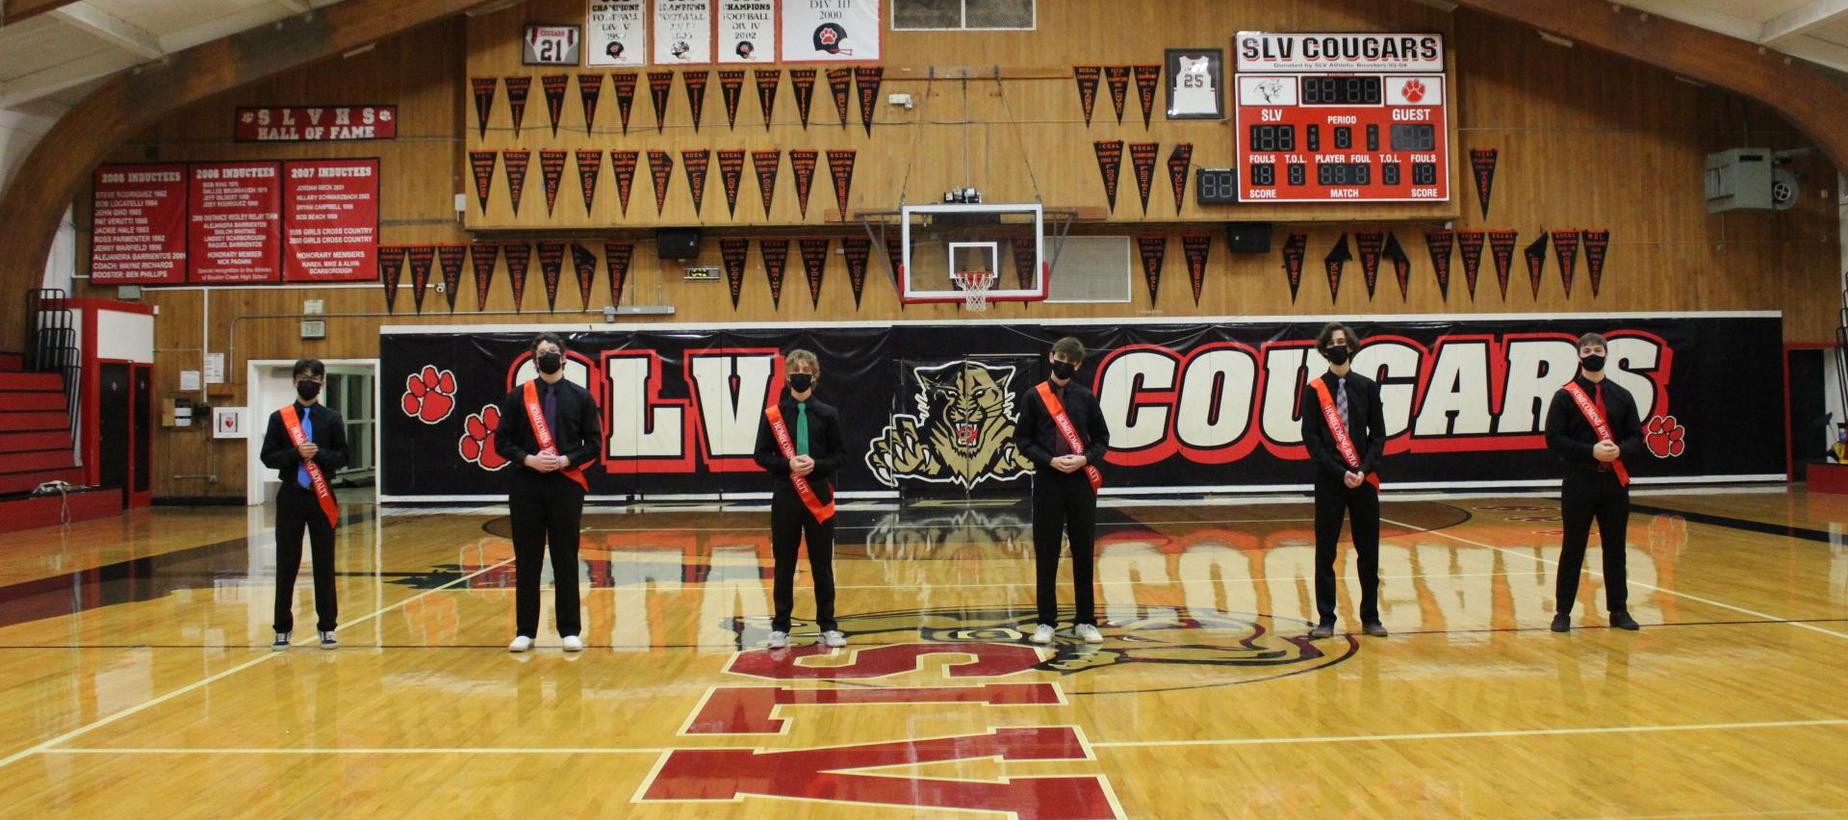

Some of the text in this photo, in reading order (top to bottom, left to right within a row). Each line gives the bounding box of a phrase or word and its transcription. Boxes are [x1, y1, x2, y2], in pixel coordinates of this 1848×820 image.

[819, 11, 842, 19] 2000
[541, 39, 562, 61] 21
[1242, 37, 1438, 61] SLV COUGARS
[1184, 74, 1204, 88] 25
[1261, 108, 1431, 122] SLV GUEST
[1327, 115, 1357, 124] PERIOD
[258, 126, 375, 140] HALL OF FAME
[1249, 155, 1436, 163] FOULS T.O.L. PLAYER FOUL T.O.L. FOULS
[222, 168, 275, 178] INDUCTEES
[291, 167, 372, 179] 2007 INDUCTEES
[1249, 189, 1438, 198] SCORE MATCH SCORE
[506, 347, 783, 473] LV
[1325, 406, 1351, 449] HOMECOMING
[311, 467, 330, 498] ROYALTY
[631, 642, 1127, 820] SLV
